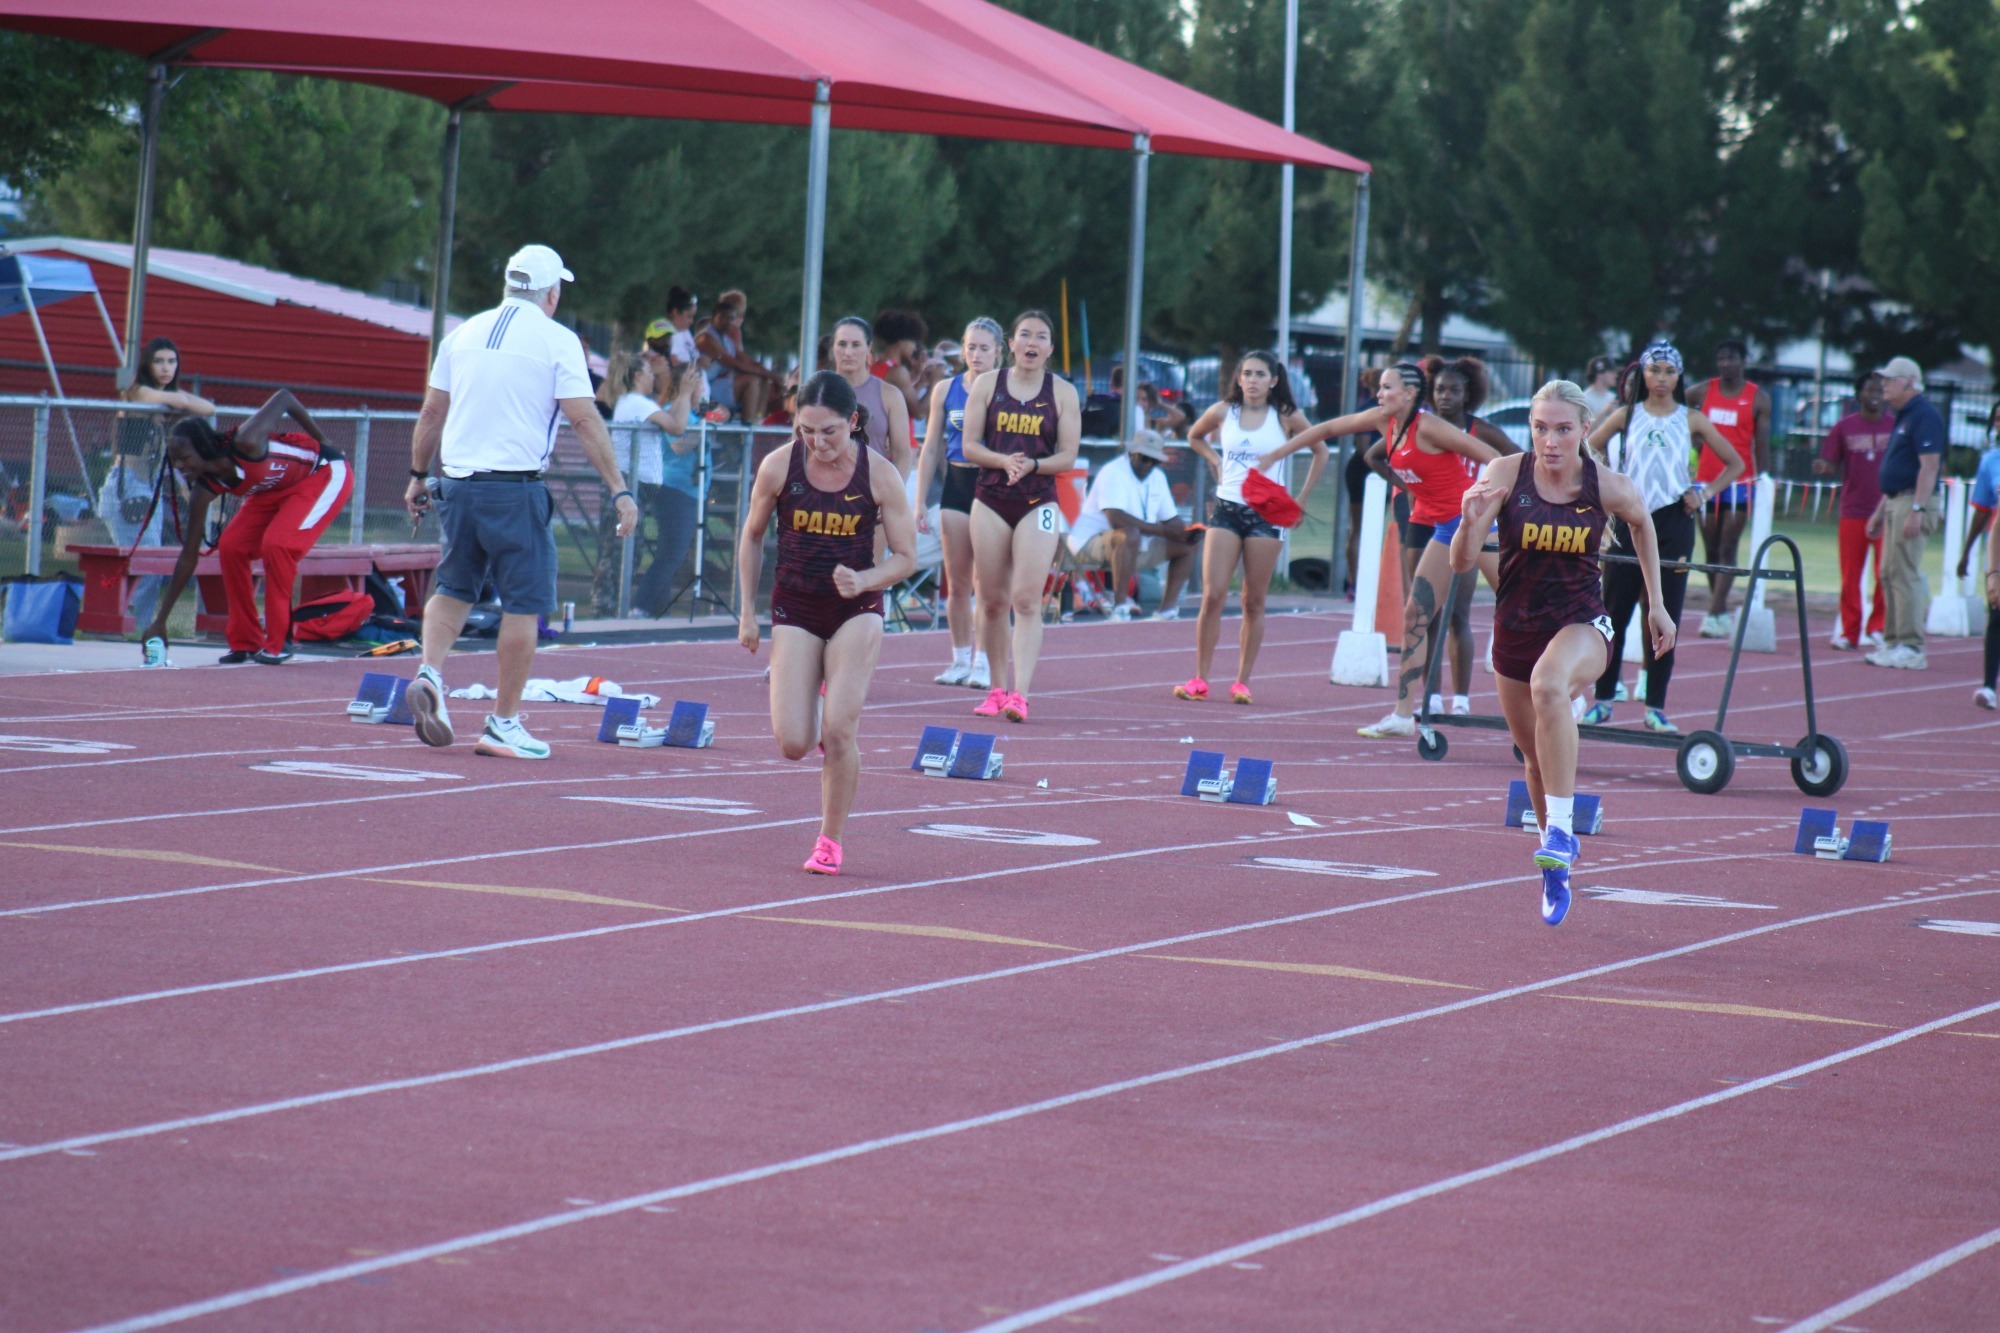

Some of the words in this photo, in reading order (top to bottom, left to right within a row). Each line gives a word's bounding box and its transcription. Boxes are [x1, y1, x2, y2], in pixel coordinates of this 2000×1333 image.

[996, 410, 1044, 436] PARK
[793, 509, 861, 536] PARK
[1042, 508, 1052, 530] 8
[1521, 522, 1592, 553] PARK
